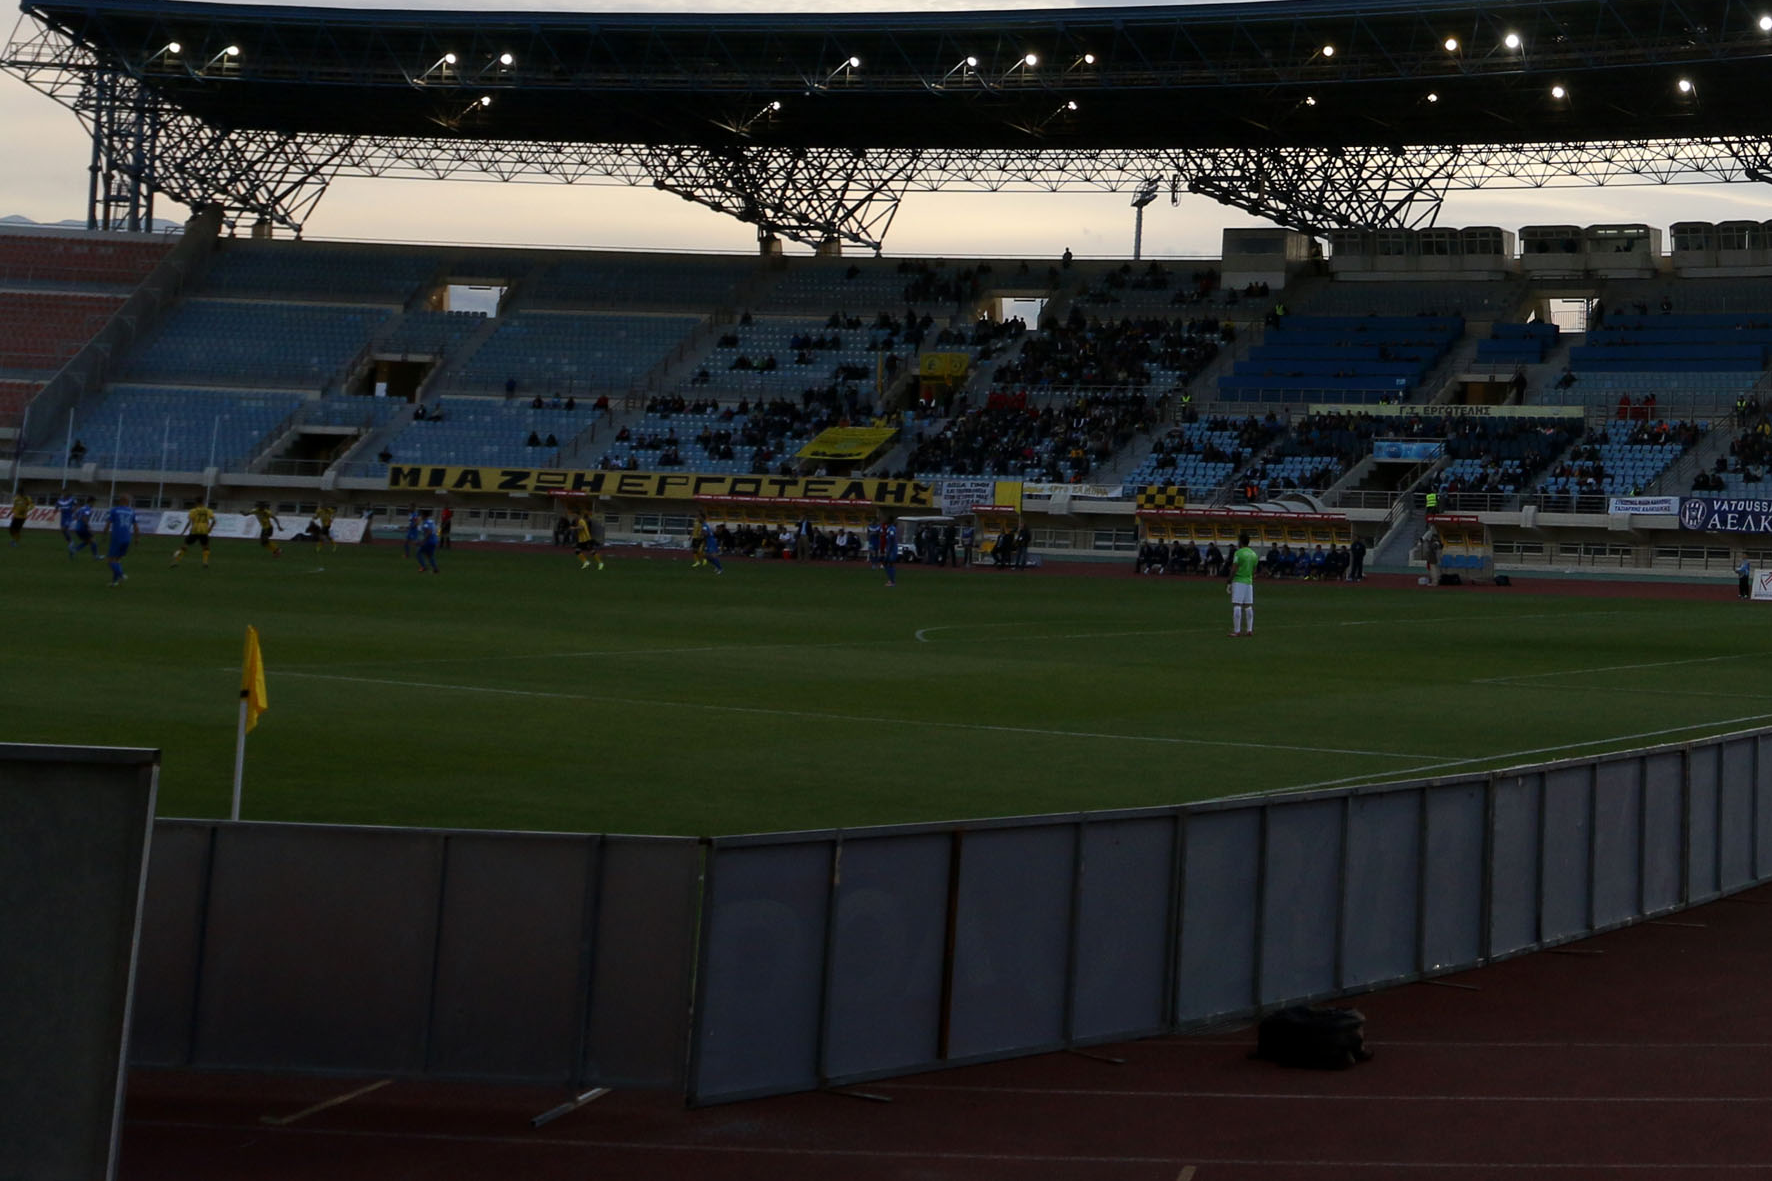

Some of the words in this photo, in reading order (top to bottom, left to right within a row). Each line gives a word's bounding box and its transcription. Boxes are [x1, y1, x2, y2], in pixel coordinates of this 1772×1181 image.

[1423, 406, 1490, 416] ΕΡΓΟΤΕΛΗΣ
[389, 466, 483, 489] ΜΙΑ
[616, 473, 932, 506] ΕΡΓΟΤΕΛΗΣ
